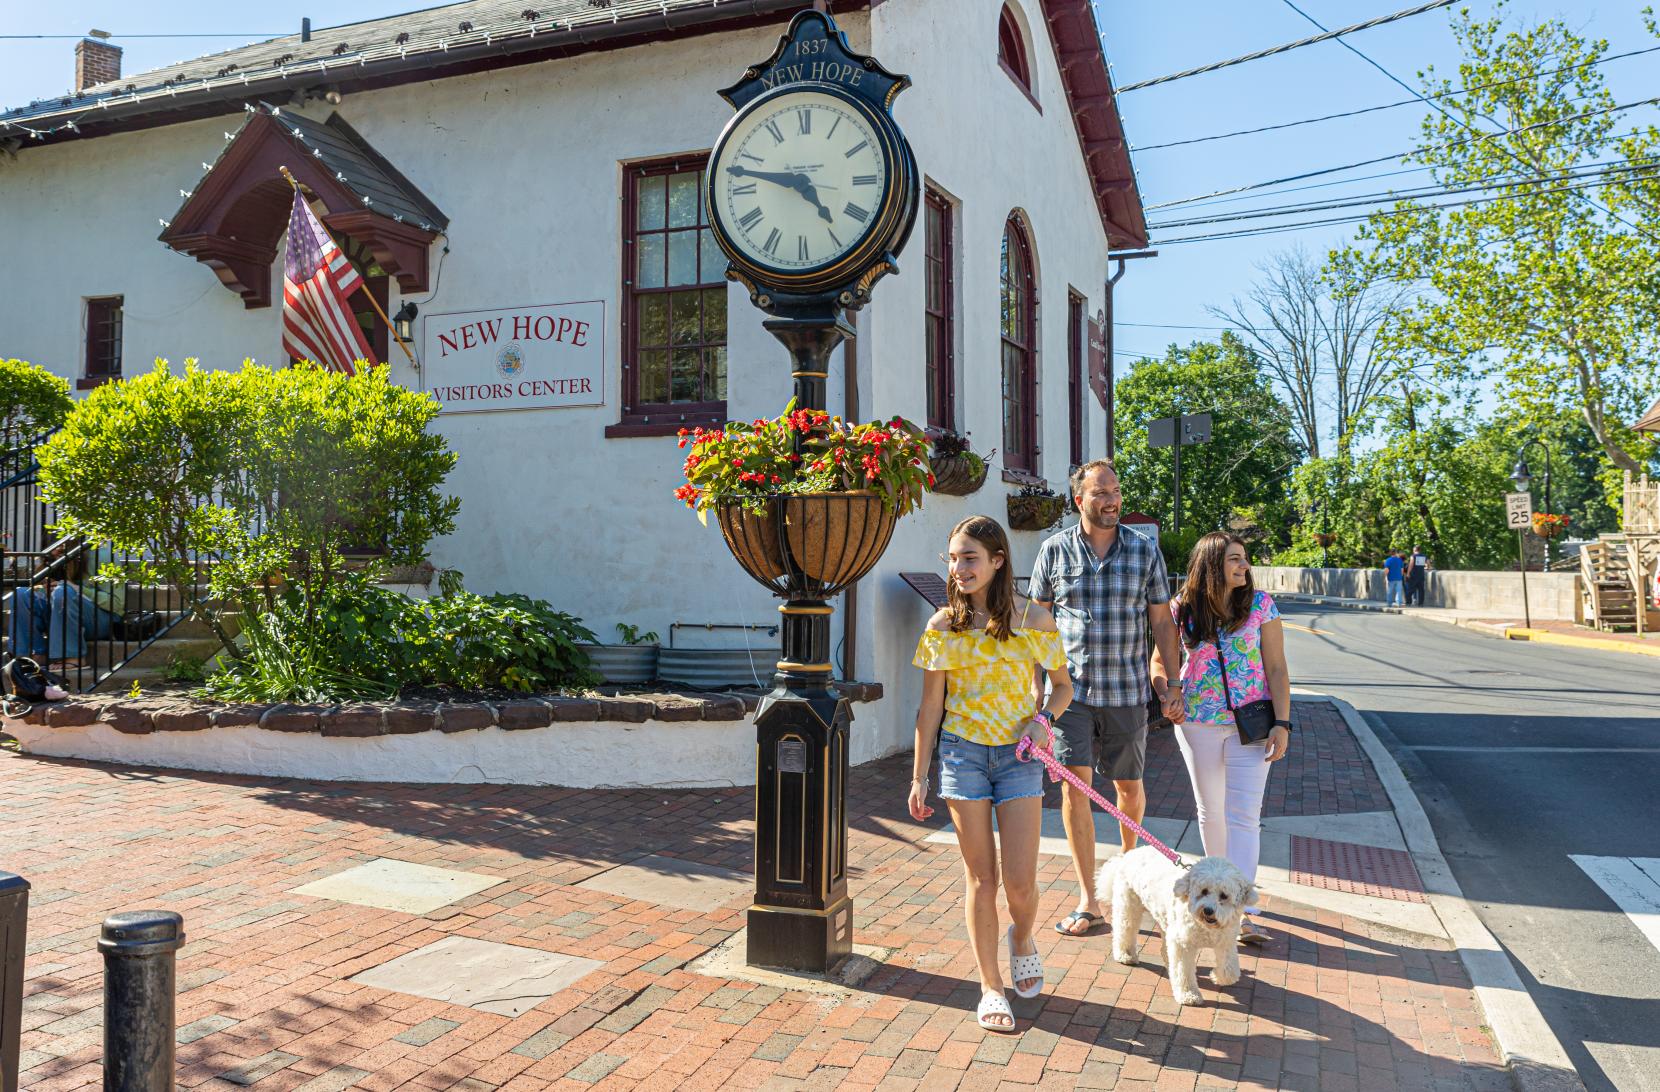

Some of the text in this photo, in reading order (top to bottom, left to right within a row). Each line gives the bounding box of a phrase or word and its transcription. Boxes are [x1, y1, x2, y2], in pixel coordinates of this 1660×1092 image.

[795, 39, 828, 56] 1837
[761, 61, 865, 90] NEW HOPE
[437, 315, 590, 357] NEW HOPE
[433, 377, 592, 401] VISITORS CENTER
[1509, 496, 1529, 504] SPEED
[1510, 511, 1529, 524] 25
